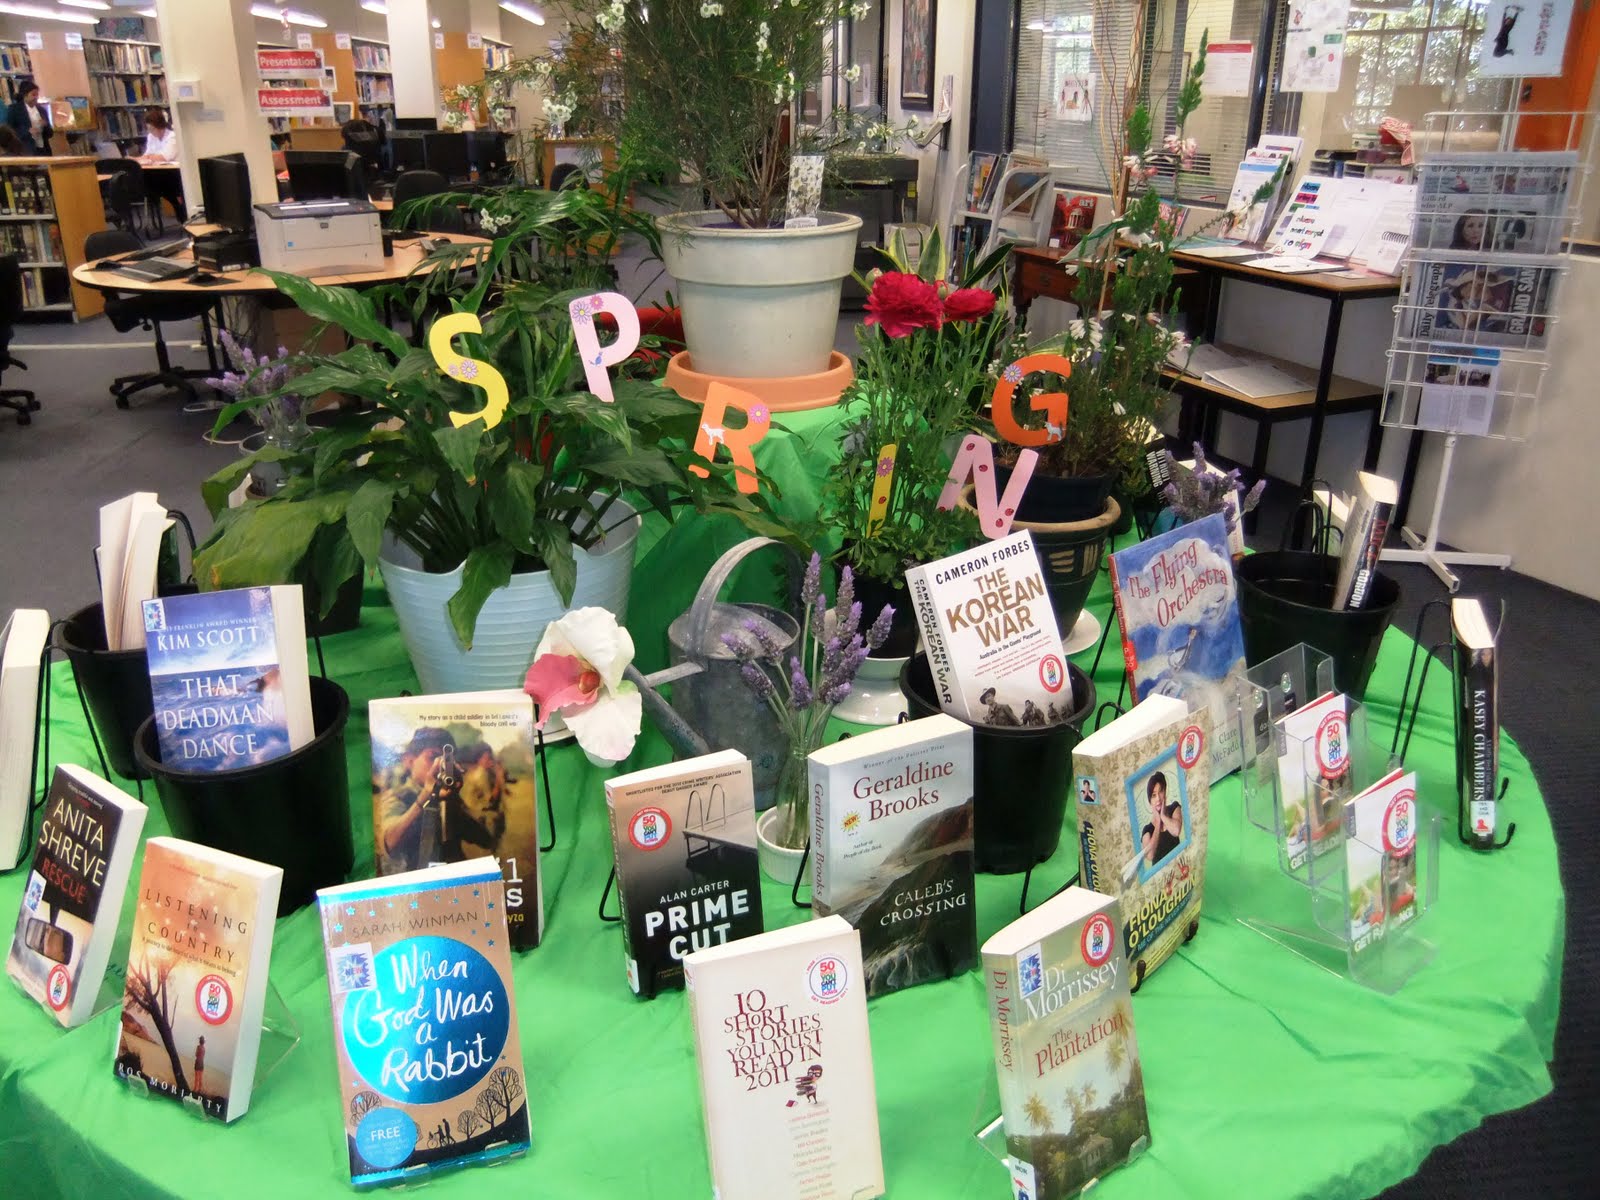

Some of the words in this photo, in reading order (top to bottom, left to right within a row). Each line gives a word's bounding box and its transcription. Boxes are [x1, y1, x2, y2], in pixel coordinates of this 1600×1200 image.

[259, 57, 317, 66] Presentation
[260, 95, 322, 105] Assessment
[1079, 199, 1094, 207] art
[1420, 312, 1434, 337] Daily
[1509, 293, 1530, 334] GRAND
[1146, 451, 1163, 488] WARNING
[935, 556, 989, 585] CAMERON
[992, 540, 1030, 563] FORBES
[973, 567, 1009, 594] THE
[1126, 576, 1150, 599] The
[1151, 541, 1197, 594] Flying
[914, 581, 923, 600] THE
[945, 573, 1045, 633] KOREAN
[1157, 567, 1228, 628] Orchestra
[1350, 569, 1370, 608] GORDON
[157, 633, 190, 651] KIM
[197, 625, 259, 647] SCOTT
[918, 602, 942, 665] KOREAN
[920, 579, 937, 628] CAMERON
[935, 633, 950, 672] FORBES
[974, 605, 1035, 648] WAR
[181, 674, 241, 699] THAT
[937, 668, 952, 704] WAR
[163, 702, 274, 730] DEADMAN
[1474, 690, 1486, 733] KASEY
[182, 733, 259, 759] DANCE
[1327, 723, 1339, 737] 50
[853, 761, 953, 800] Geraldine
[1473, 733, 1485, 801] CHAMBERS
[642, 815, 656, 826] 50
[814, 783, 823, 851] Geraldine
[869, 786, 940, 822] Brooks
[1396, 801, 1408, 816] 50
[53, 798, 104, 851] ANITA
[39, 820, 107, 887] SHREVE
[1086, 827, 1097, 860] FIONA
[42, 857, 87, 904] RESCUE
[659, 889, 687, 904] ALAN
[691, 880, 730, 897] CARTER
[816, 853, 825, 896] Brooks
[894, 878, 954, 907] CALEB'S
[144, 888, 248, 935] LISTENING
[352, 922, 403, 938] SARAH
[409, 911, 480, 930] WINMAN
[644, 889, 750, 938] PRIME
[880, 893, 967, 927] CROSSING
[1129, 890, 1167, 932] FIONA
[148, 922, 235, 963] COUNTRY
[669, 923, 731, 960] CUT
[1354, 933, 1371, 952] GET
[390, 943, 469, 993] When
[820, 960, 835, 972] 50
[821, 973, 836, 982] YOU
[993, 970, 1008, 990] Di
[1044, 963, 1065, 993] Di
[210, 983, 221, 995] 50
[821, 983, 836, 992] PUT
[1025, 956, 1120, 1025] Morrissey
[354, 984, 429, 1048] God
[435, 986, 494, 1024] Was
[415, 1022, 438, 1045] a
[736, 1013, 820, 1046] STORIES
[996, 995, 1013, 1072] Morrissey
[726, 1042, 766, 1063] YOU
[772, 1028, 823, 1054] MUST
[1035, 1011, 1123, 1078] Plantation
[1052, 1027, 1072, 1047] The
[381, 1032, 493, 1092] Rabbit
[733, 1049, 793, 1077] READ
[800, 1041, 822, 1062] IN
[117, 1062, 142, 1079] ROS
[149, 1076, 223, 1113] MORIARTY
[746, 1066, 790, 1091] 2011
[371, 1126, 401, 1142] FREE
